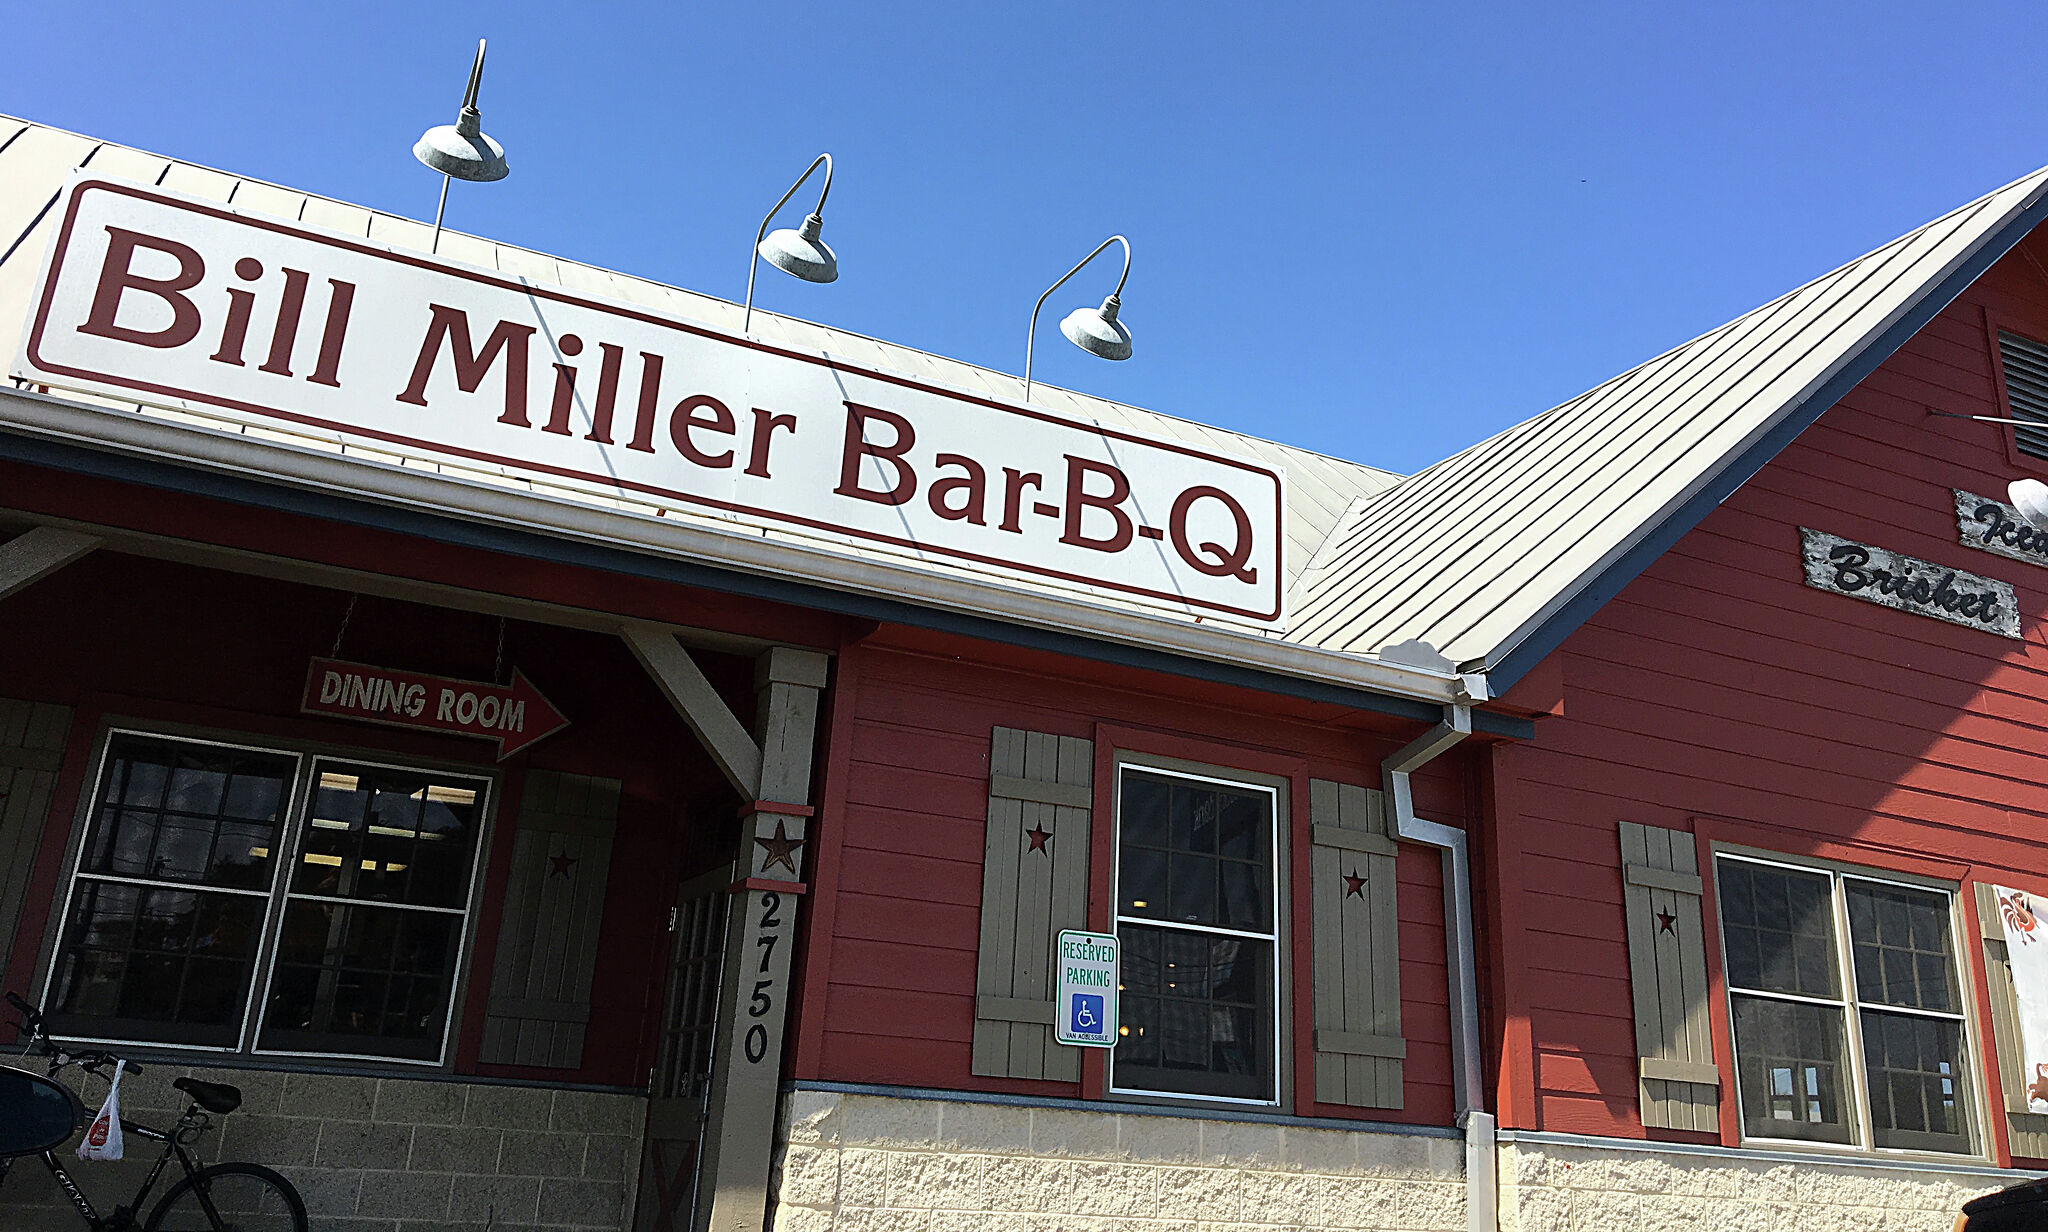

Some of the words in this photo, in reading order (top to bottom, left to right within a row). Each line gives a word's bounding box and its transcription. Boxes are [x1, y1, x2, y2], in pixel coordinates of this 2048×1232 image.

[76, 225, 356, 388] Bill
[396, 302, 796, 481] Miller
[833, 400, 1258, 585] Bar-B-Q
[1829, 545, 1998, 623] Brisket
[319, 670, 426, 718] DINING
[436, 688, 525, 733] ROOM
[744, 892, 781, 1064] 2750
[1063, 941, 1115, 963] RESERVED
[1066, 966, 1111, 988] PARKING
[1065, 1032, 1077, 1040] VAN
[1077, 1033, 1109, 1042] ACESSIBLE
